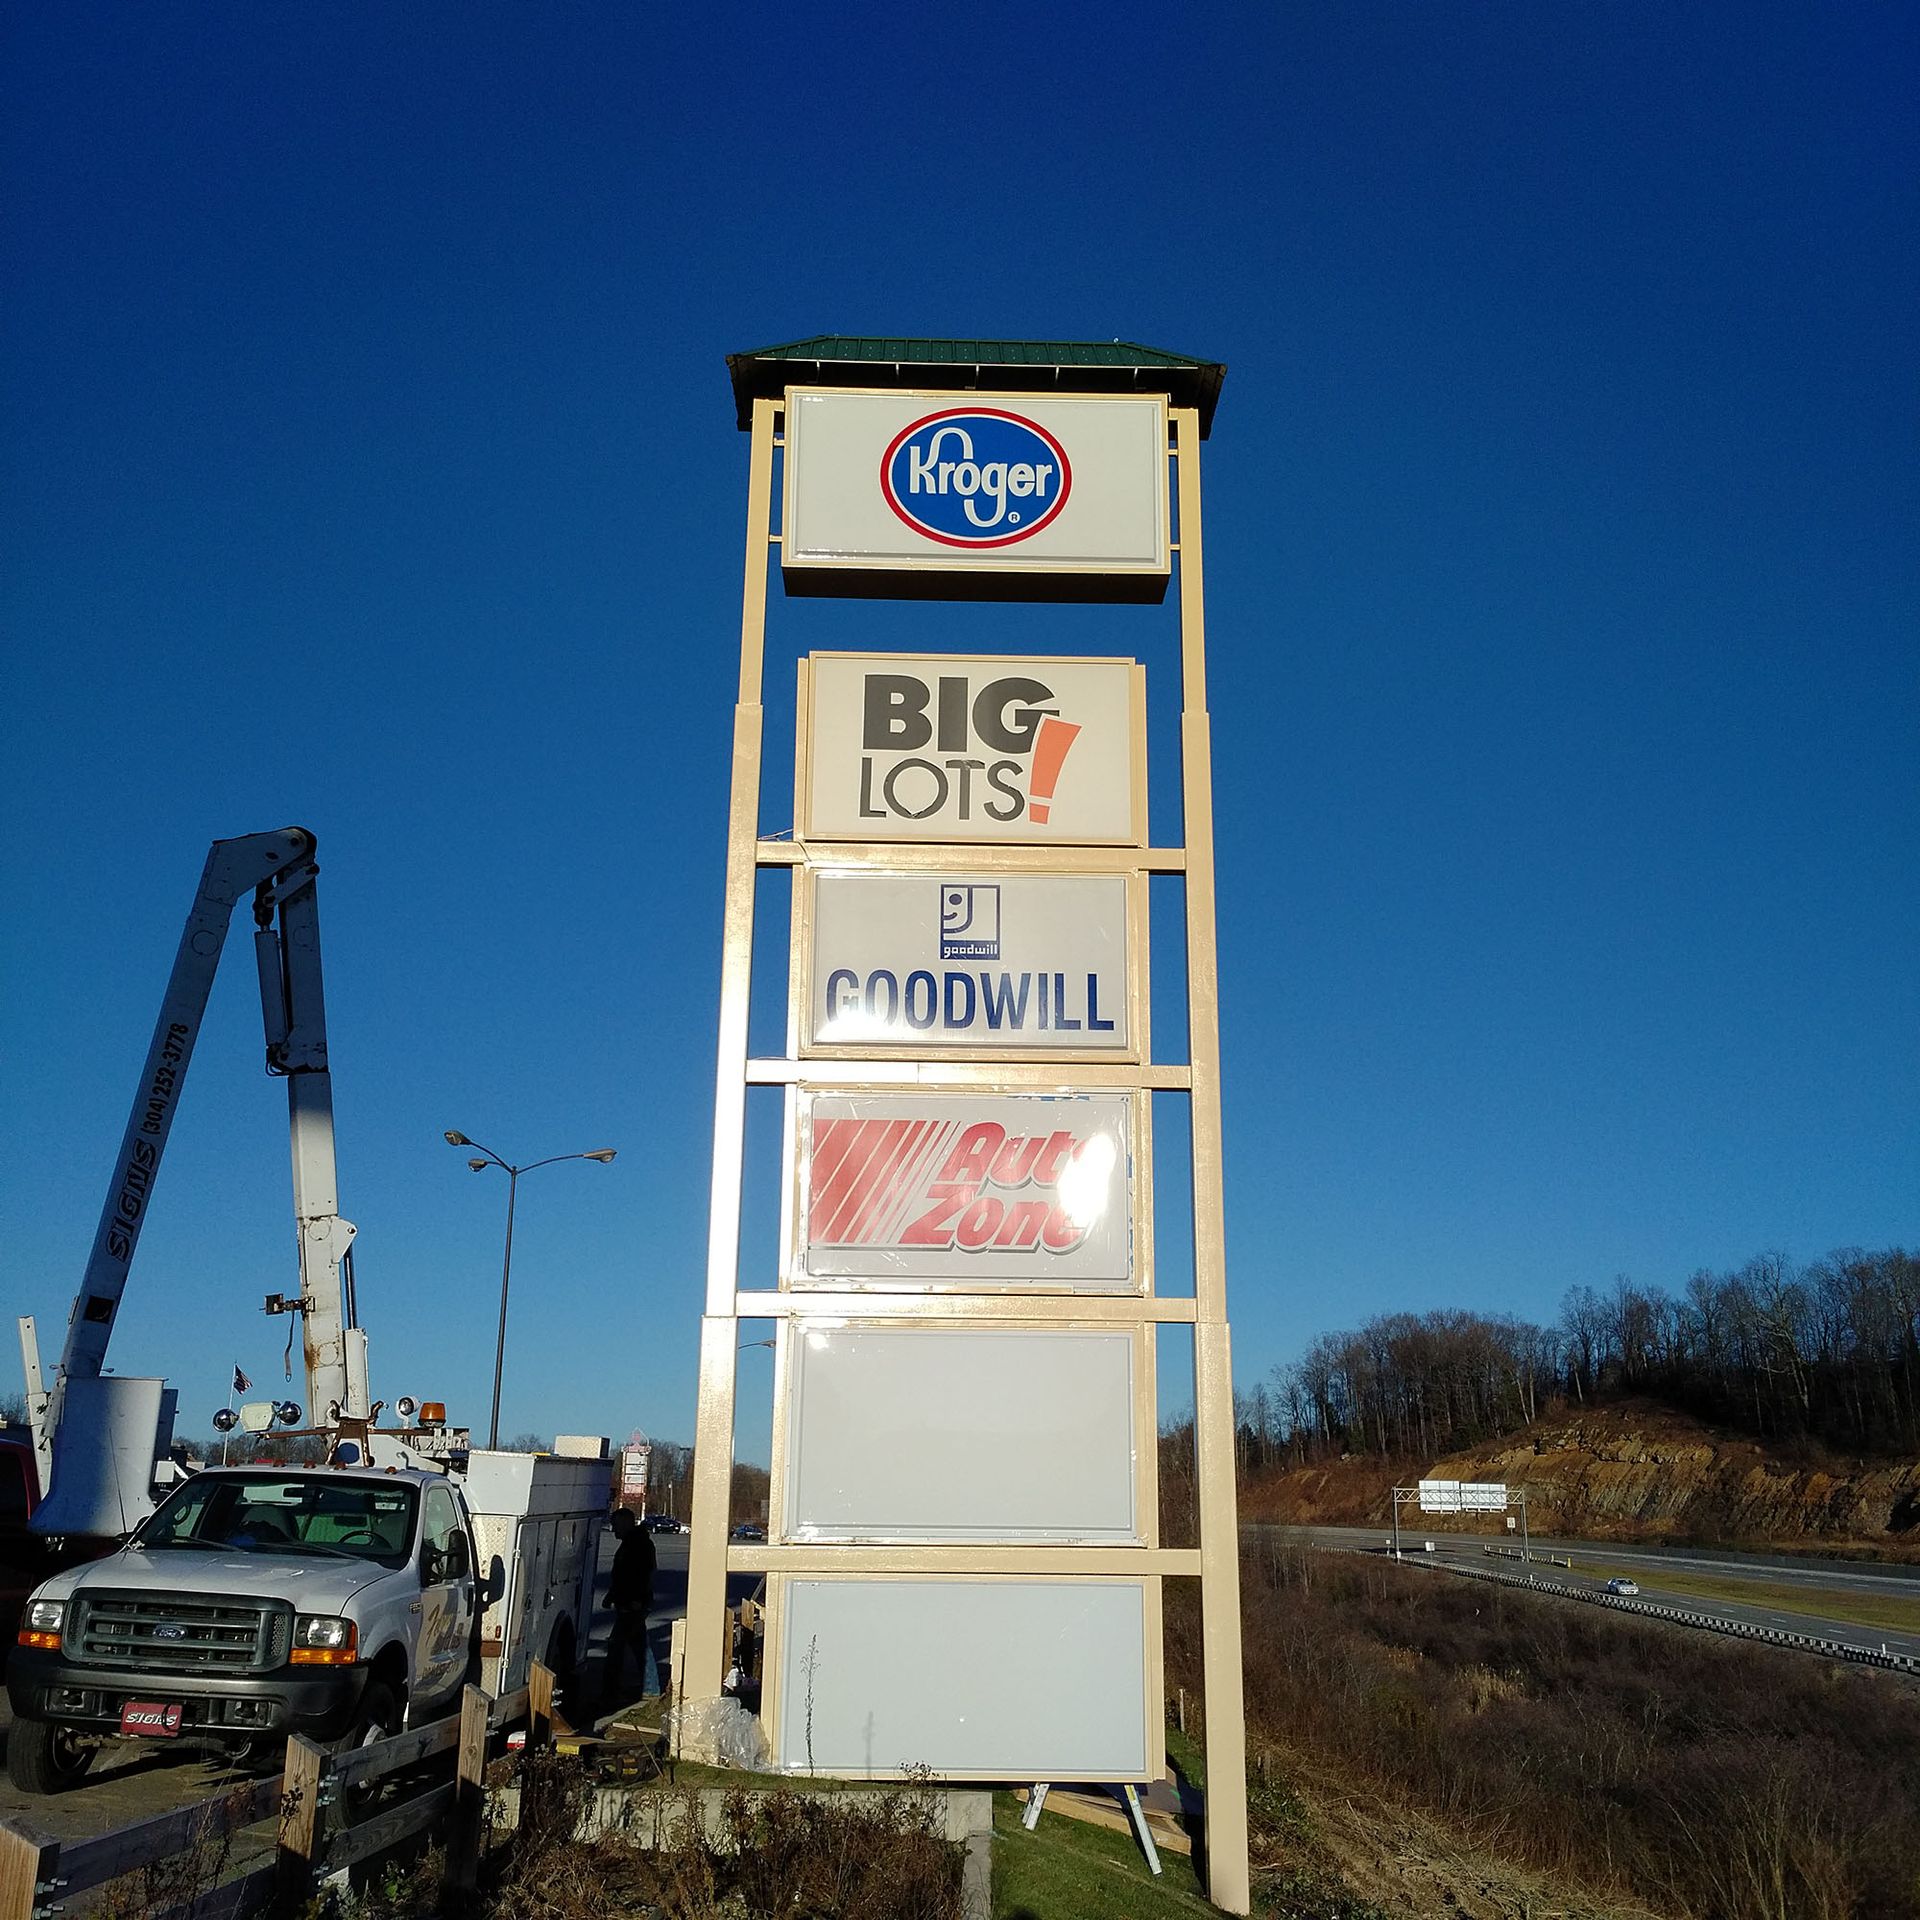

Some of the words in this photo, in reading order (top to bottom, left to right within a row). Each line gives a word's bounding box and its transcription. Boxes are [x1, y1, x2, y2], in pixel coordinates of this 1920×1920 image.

[909, 427, 1052, 527] Kroger
[863, 674, 1060, 754] BIG
[943, 944, 998, 959] goodwill
[827, 969, 1115, 1031] GOODWILL
[937, 1121, 1104, 1183] Aut
[105, 1138, 157, 1263] SIGNS
